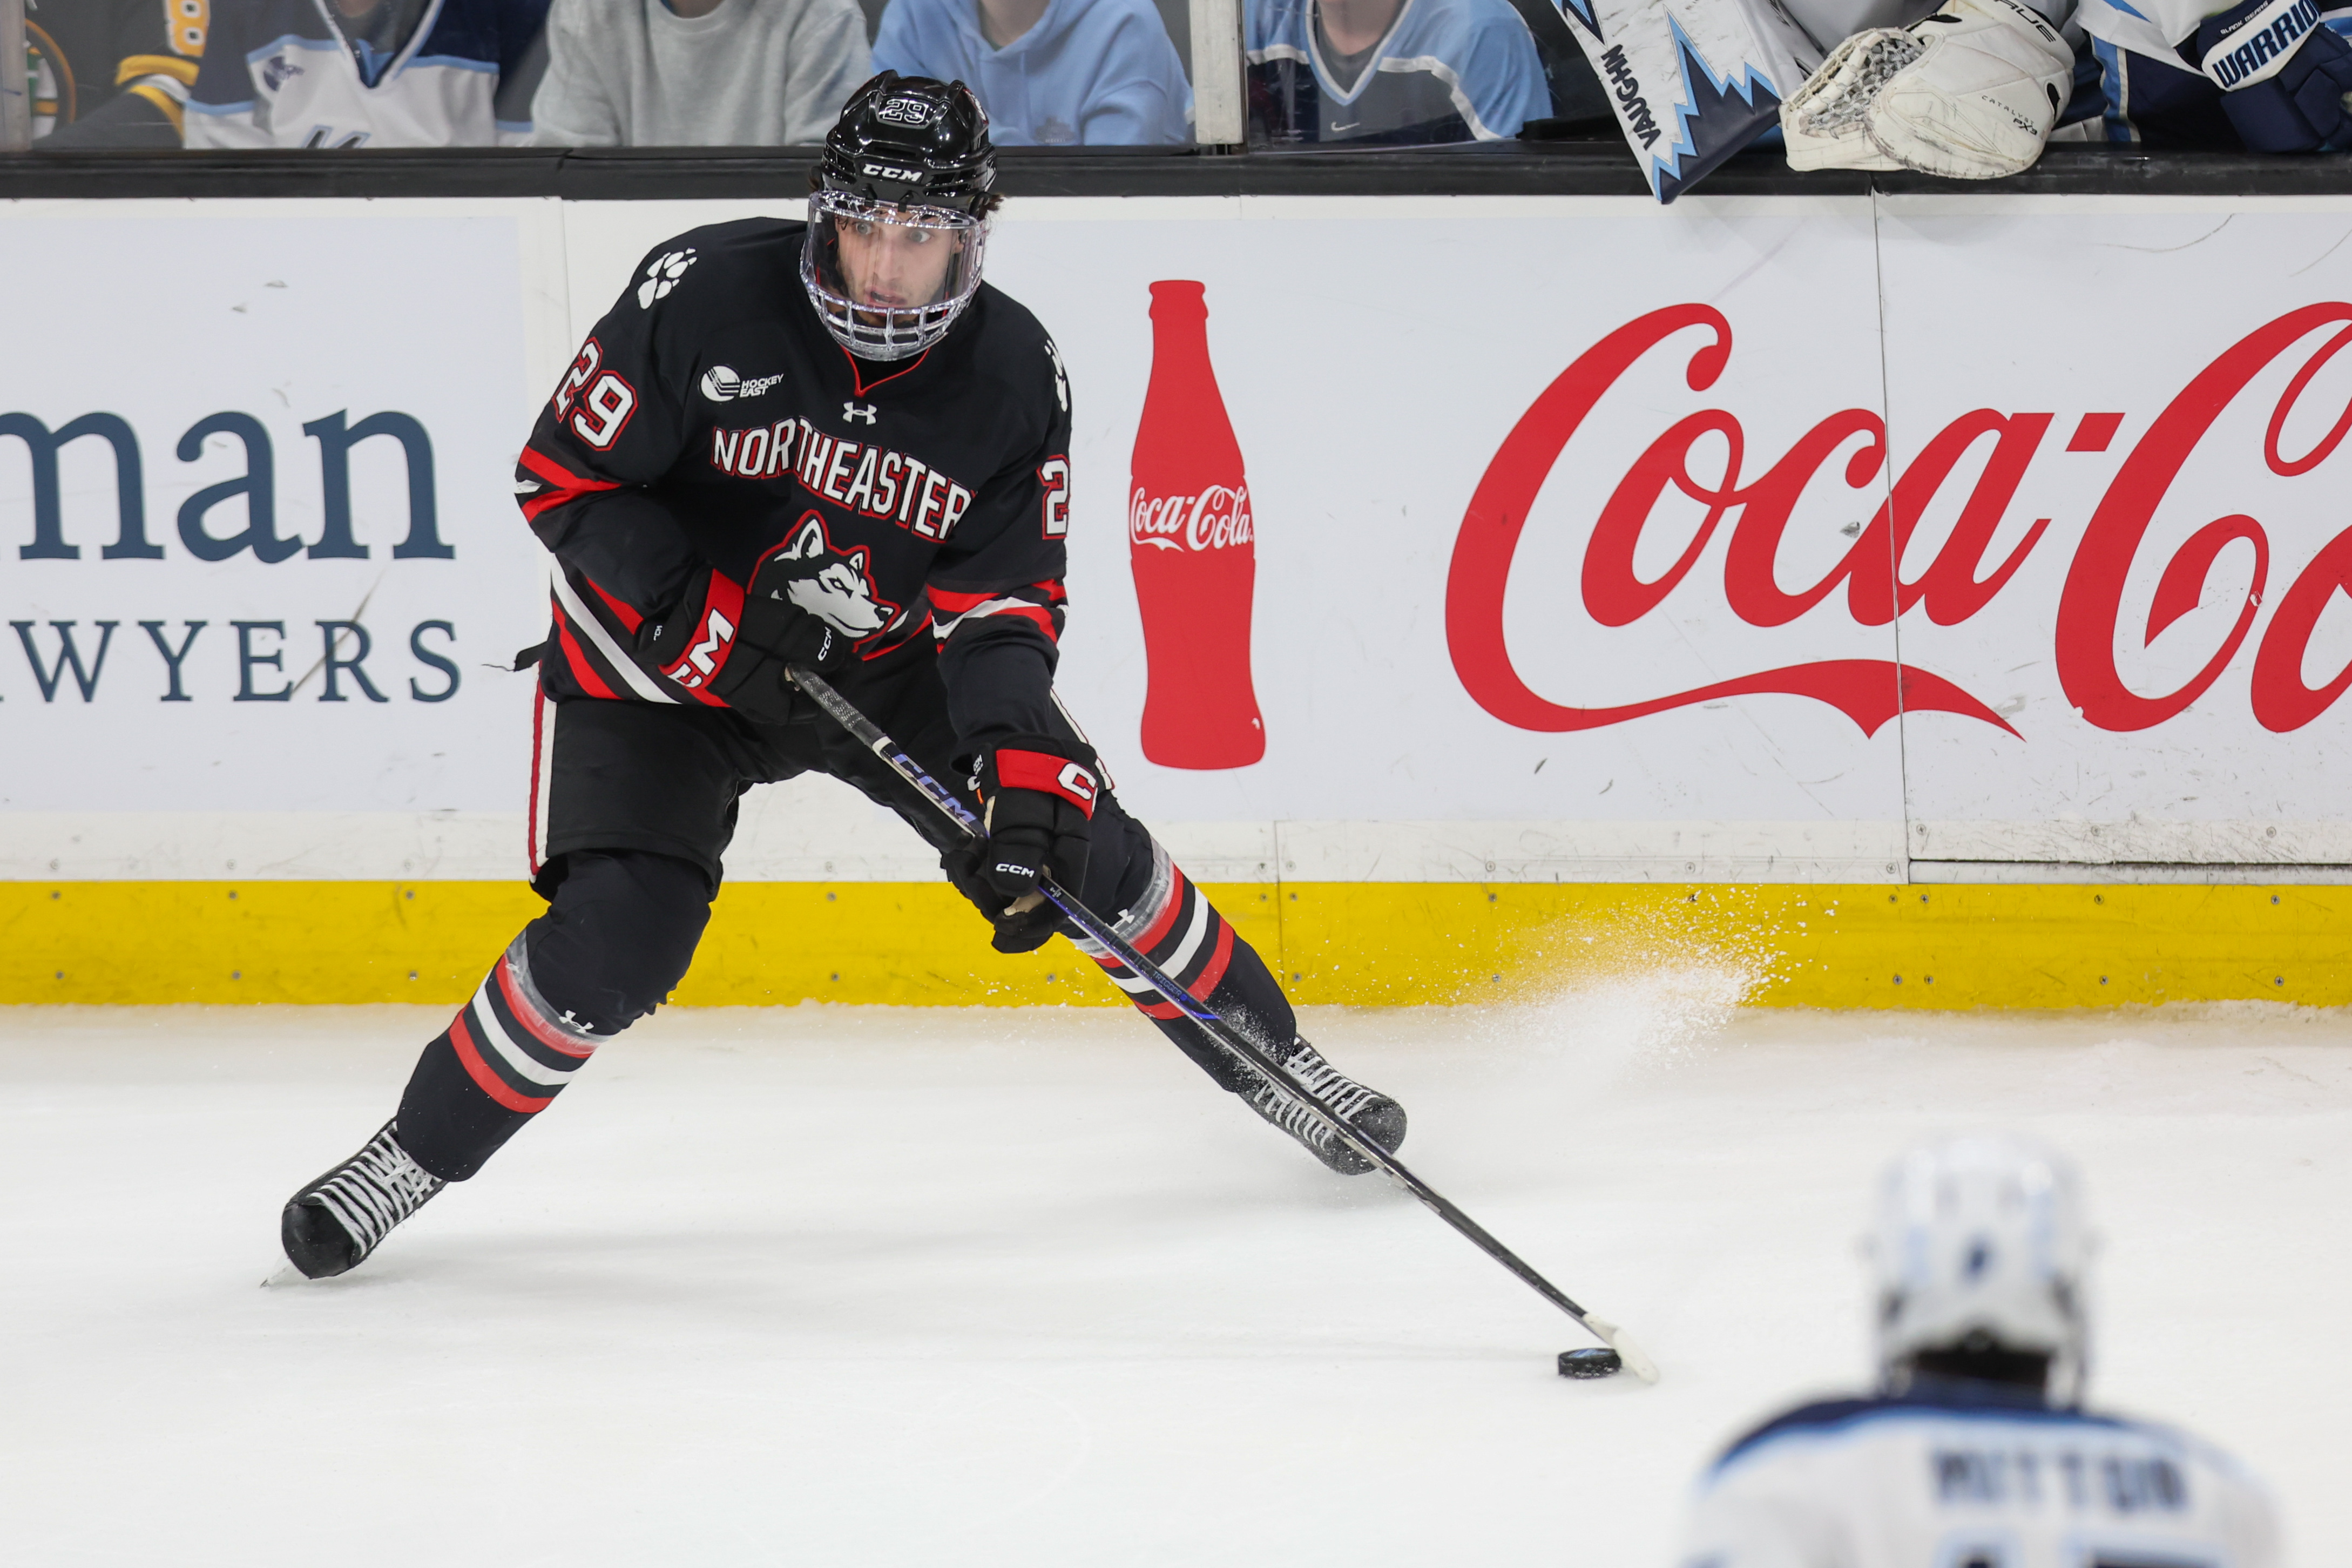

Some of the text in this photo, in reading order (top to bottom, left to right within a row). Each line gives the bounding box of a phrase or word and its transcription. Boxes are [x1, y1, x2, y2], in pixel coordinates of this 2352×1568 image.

[2245, 1, 2269, 22] BEARS
[2212, 0, 2319, 89] WARRIO
[882, 99, 929, 124] 29
[1600, 44, 1661, 151] VAUGHN
[1982, 95, 2035, 125] CATALYST
[863, 163, 923, 182] CCM
[552, 336, 639, 451] 29
[739, 386, 769, 398] EAST
[741, 373, 784, 389] HOCKEY
[0, 409, 456, 564] man
[1131, 484, 1253, 552] Coca-Cola
[817, 626, 833, 661] CCM
[0, 620, 462, 703] WYERS
[892, 754, 978, 827] CCM
[996, 863, 1035, 878] CCM
[1153, 970, 1182, 997] TRIGGER
